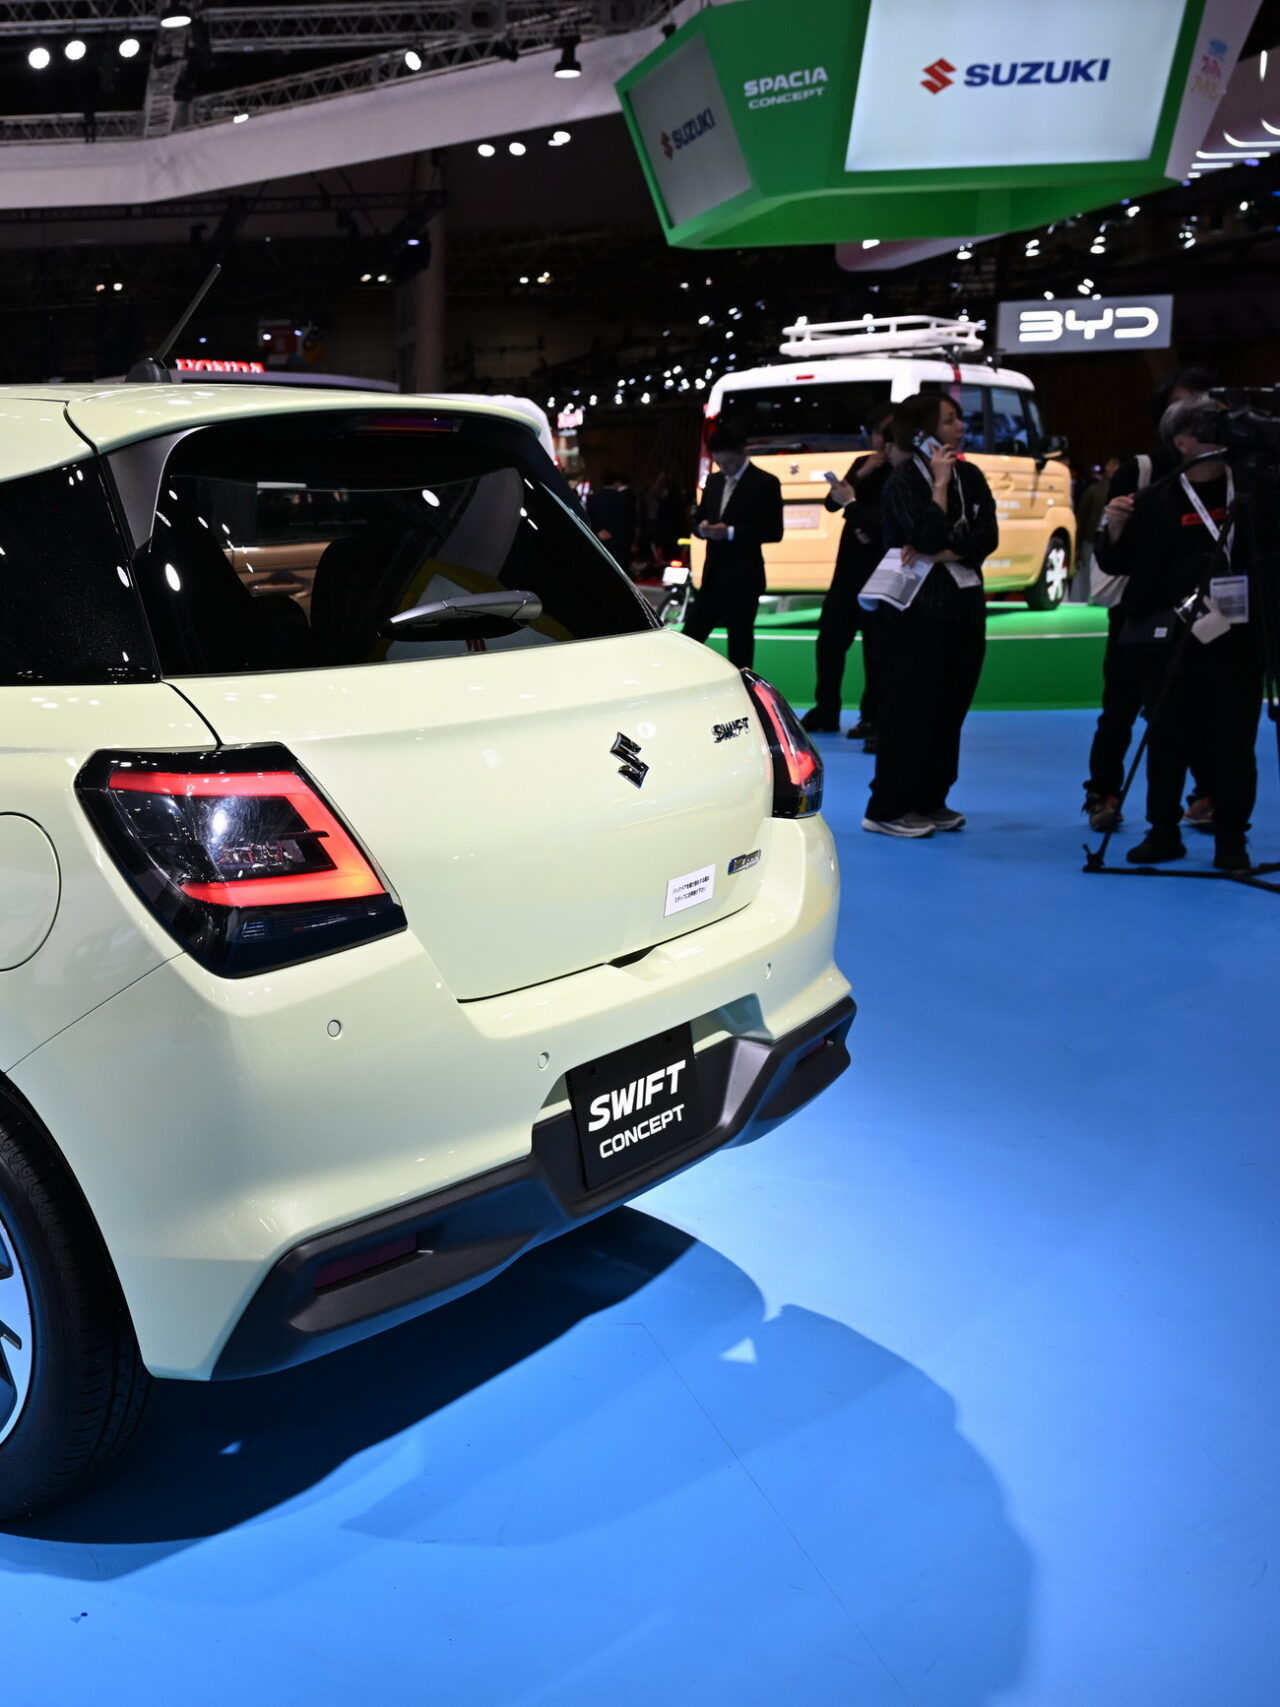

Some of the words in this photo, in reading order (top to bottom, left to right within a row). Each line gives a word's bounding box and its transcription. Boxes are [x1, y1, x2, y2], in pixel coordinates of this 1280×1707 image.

[743, 66, 828, 97] SPACIA
[964, 58, 1110, 87] SUZUKI
[748, 87, 824, 110] CONCEPT
[671, 107, 716, 150] SUZUKI
[1018, 306, 1159, 342] BYD
[712, 717, 749, 743] SWIFT
[588, 1059, 686, 1132] SWIFT
[599, 1103, 685, 1159] CONCEPT
